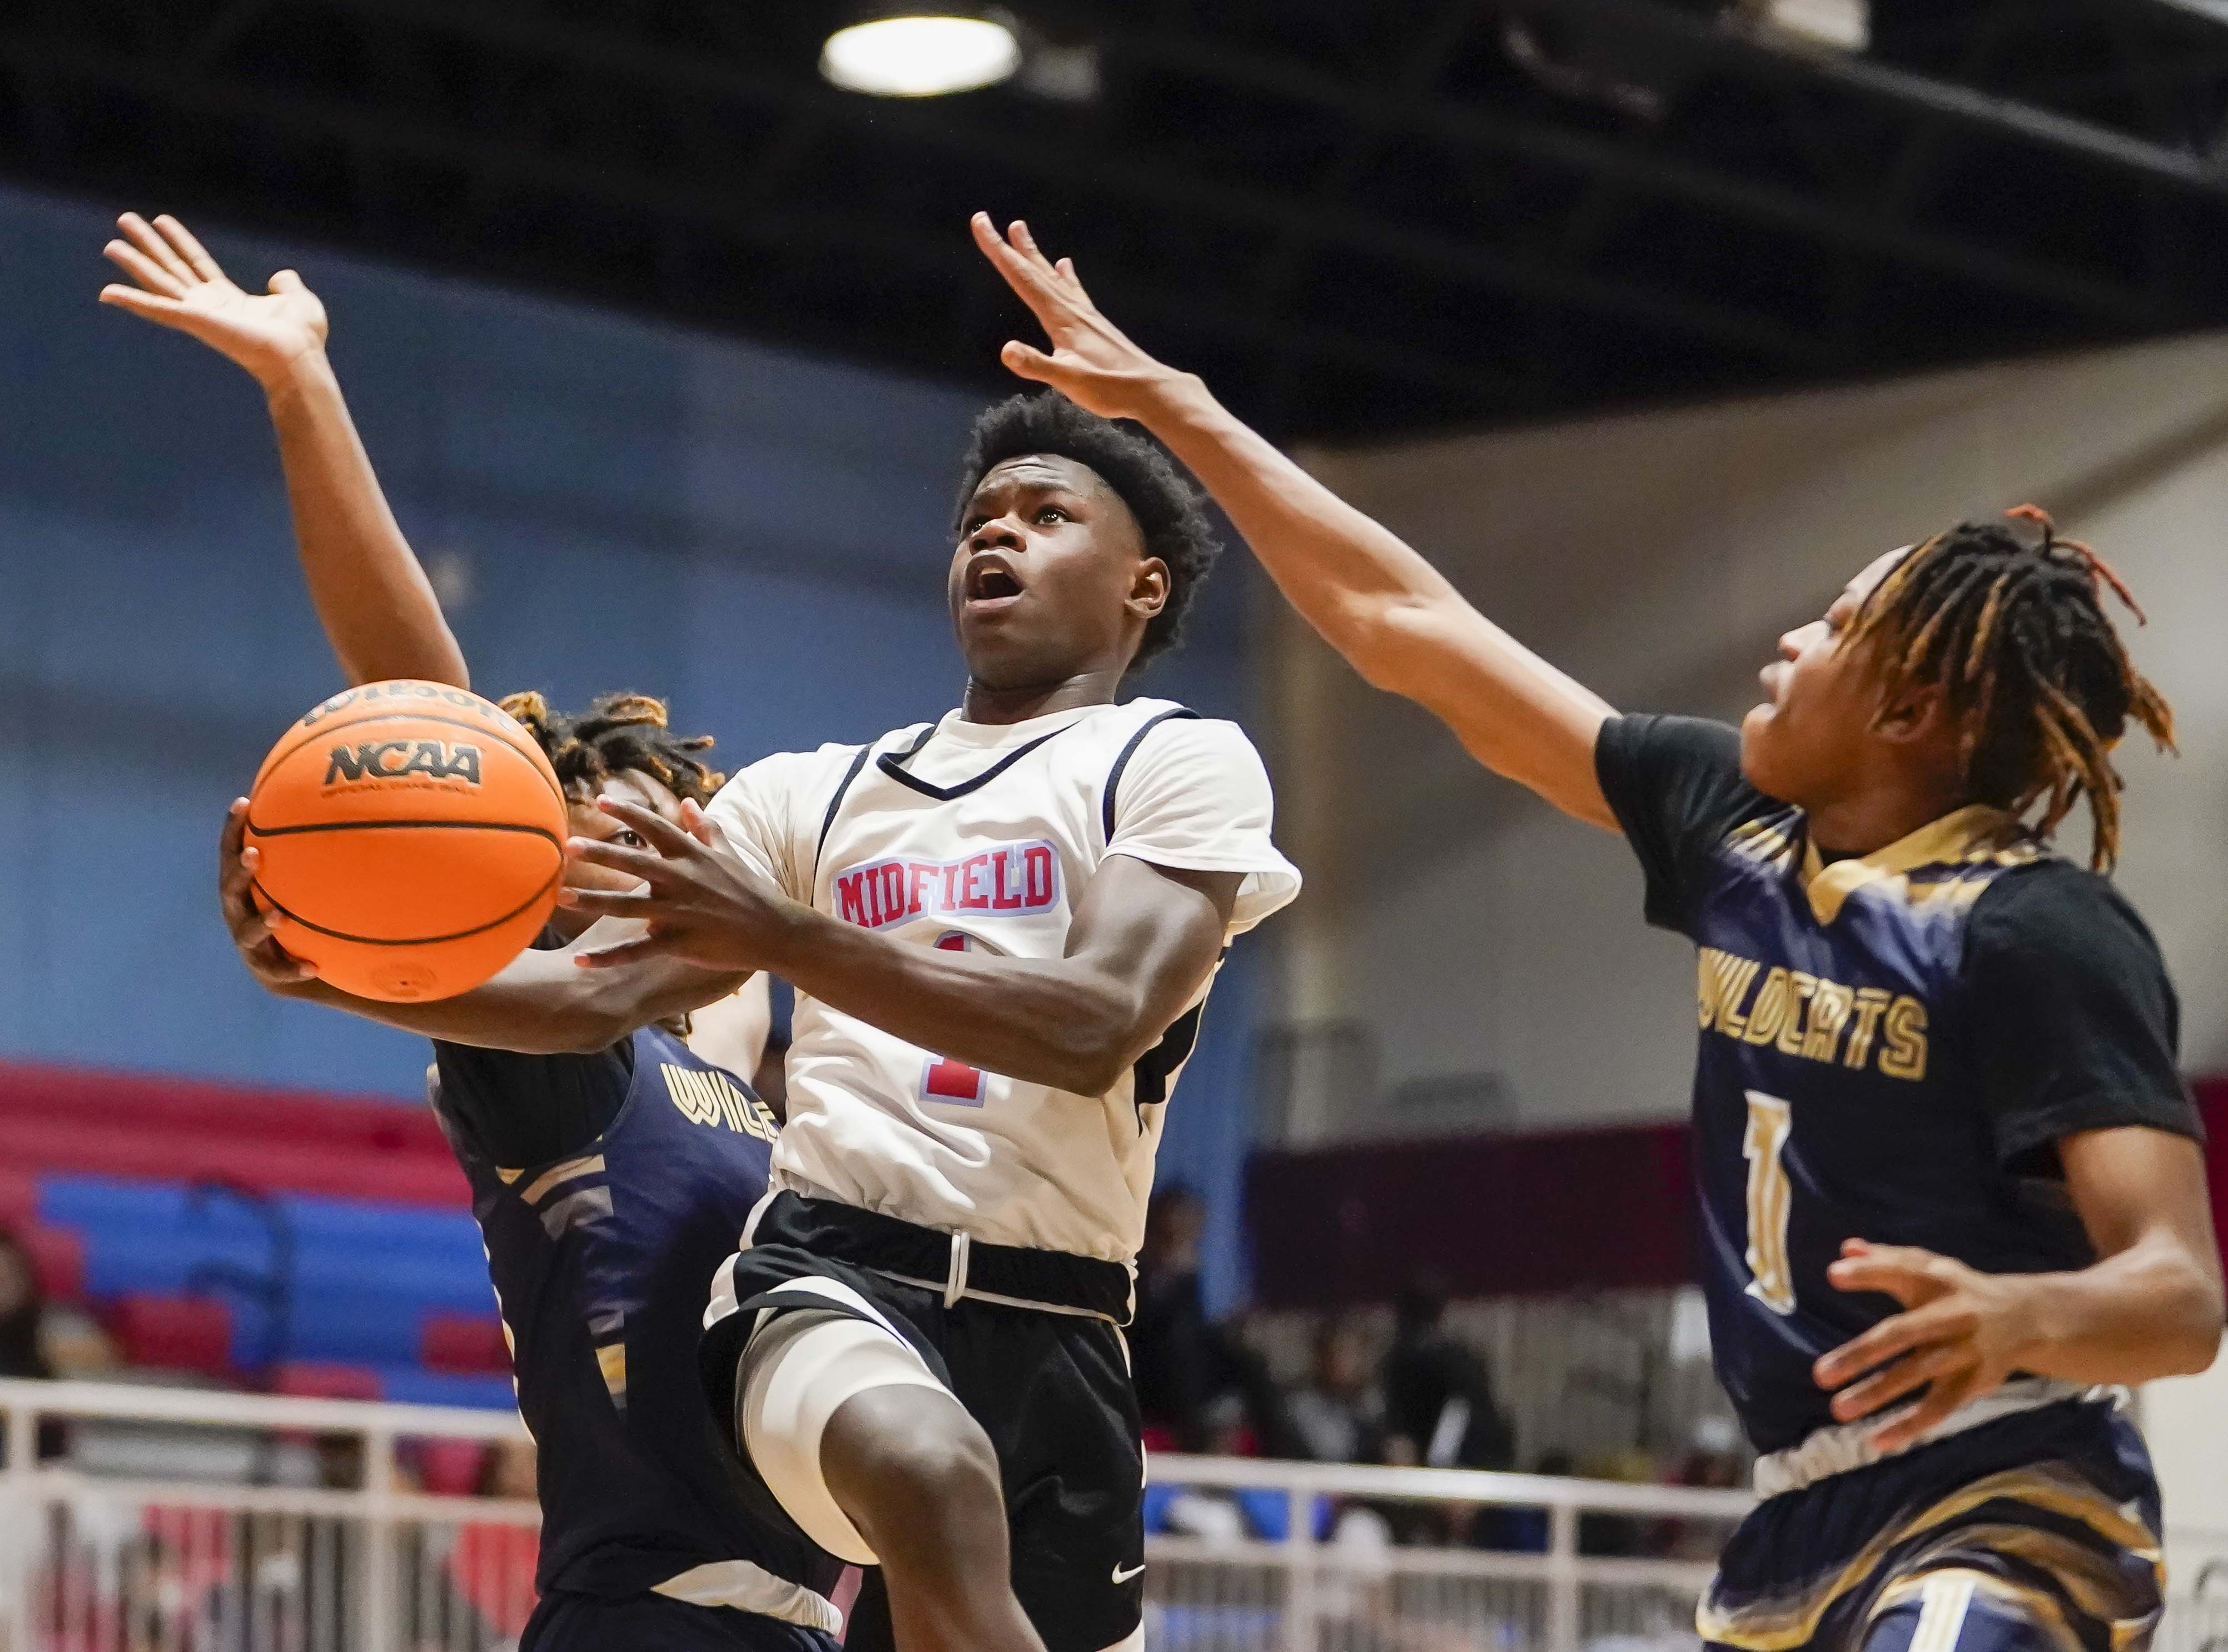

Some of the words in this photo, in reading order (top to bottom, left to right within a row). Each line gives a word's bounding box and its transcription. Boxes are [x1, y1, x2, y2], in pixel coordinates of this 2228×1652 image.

[324, 740, 481, 785] NCAA
[837, 845, 1054, 929] MIDFIELD
[1743, 1089, 1798, 1316] 1
